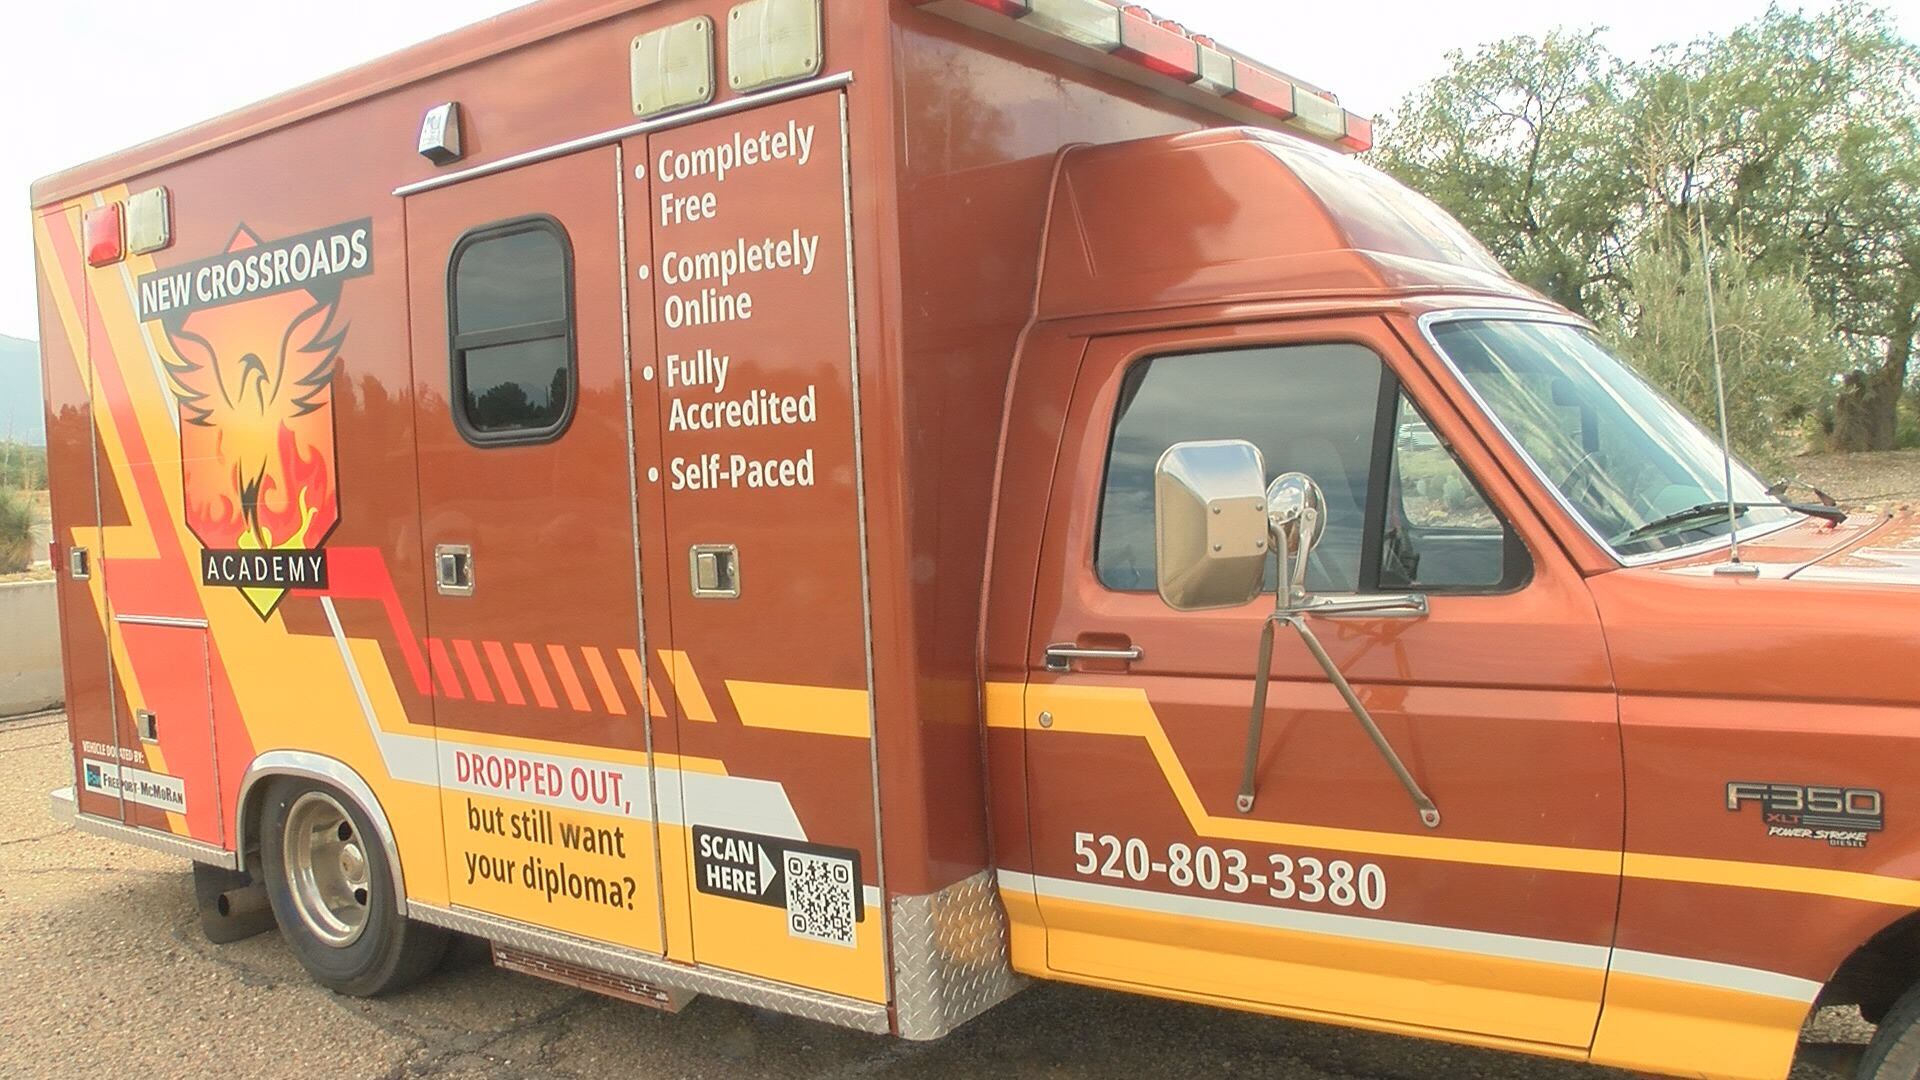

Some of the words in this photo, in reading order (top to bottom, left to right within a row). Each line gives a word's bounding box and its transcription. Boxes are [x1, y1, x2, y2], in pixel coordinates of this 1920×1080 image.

[658, 120, 814, 182] Completely
[660, 191, 718, 227] Free
[141, 271, 193, 315] NEW
[196, 228, 368, 303] CROSSROADS
[661, 229, 819, 286] Completely
[664, 289, 753, 329] Online
[666, 349, 730, 394] Fully
[668, 384, 817, 433] Accredited
[671, 449, 815, 491] Self-Paced
[206, 555, 323, 582] ACADEMY
[82, 740, 106, 755] VEHICLE
[106, 744, 133, 761] DOATED
[134, 750, 144, 763] BY:
[455, 751, 564, 797] DROPPED
[570, 767, 632, 814] OUT,
[1727, 783, 1882, 815] F350
[467, 798, 504, 836] but
[511, 809, 554, 846] still
[559, 822, 626, 859] want
[1766, 813, 1801, 824] XLT
[1768, 826, 1812, 838] POWER
[1813, 829, 1867, 841] STROKE
[700, 834, 755, 866] SCAN
[1830, 839, 1866, 848] DIESEL
[465, 850, 516, 885] your
[522, 855, 637, 911] diploma?
[706, 865, 757, 896] HERE
[1075, 831, 1387, 911] 520-803-3380
